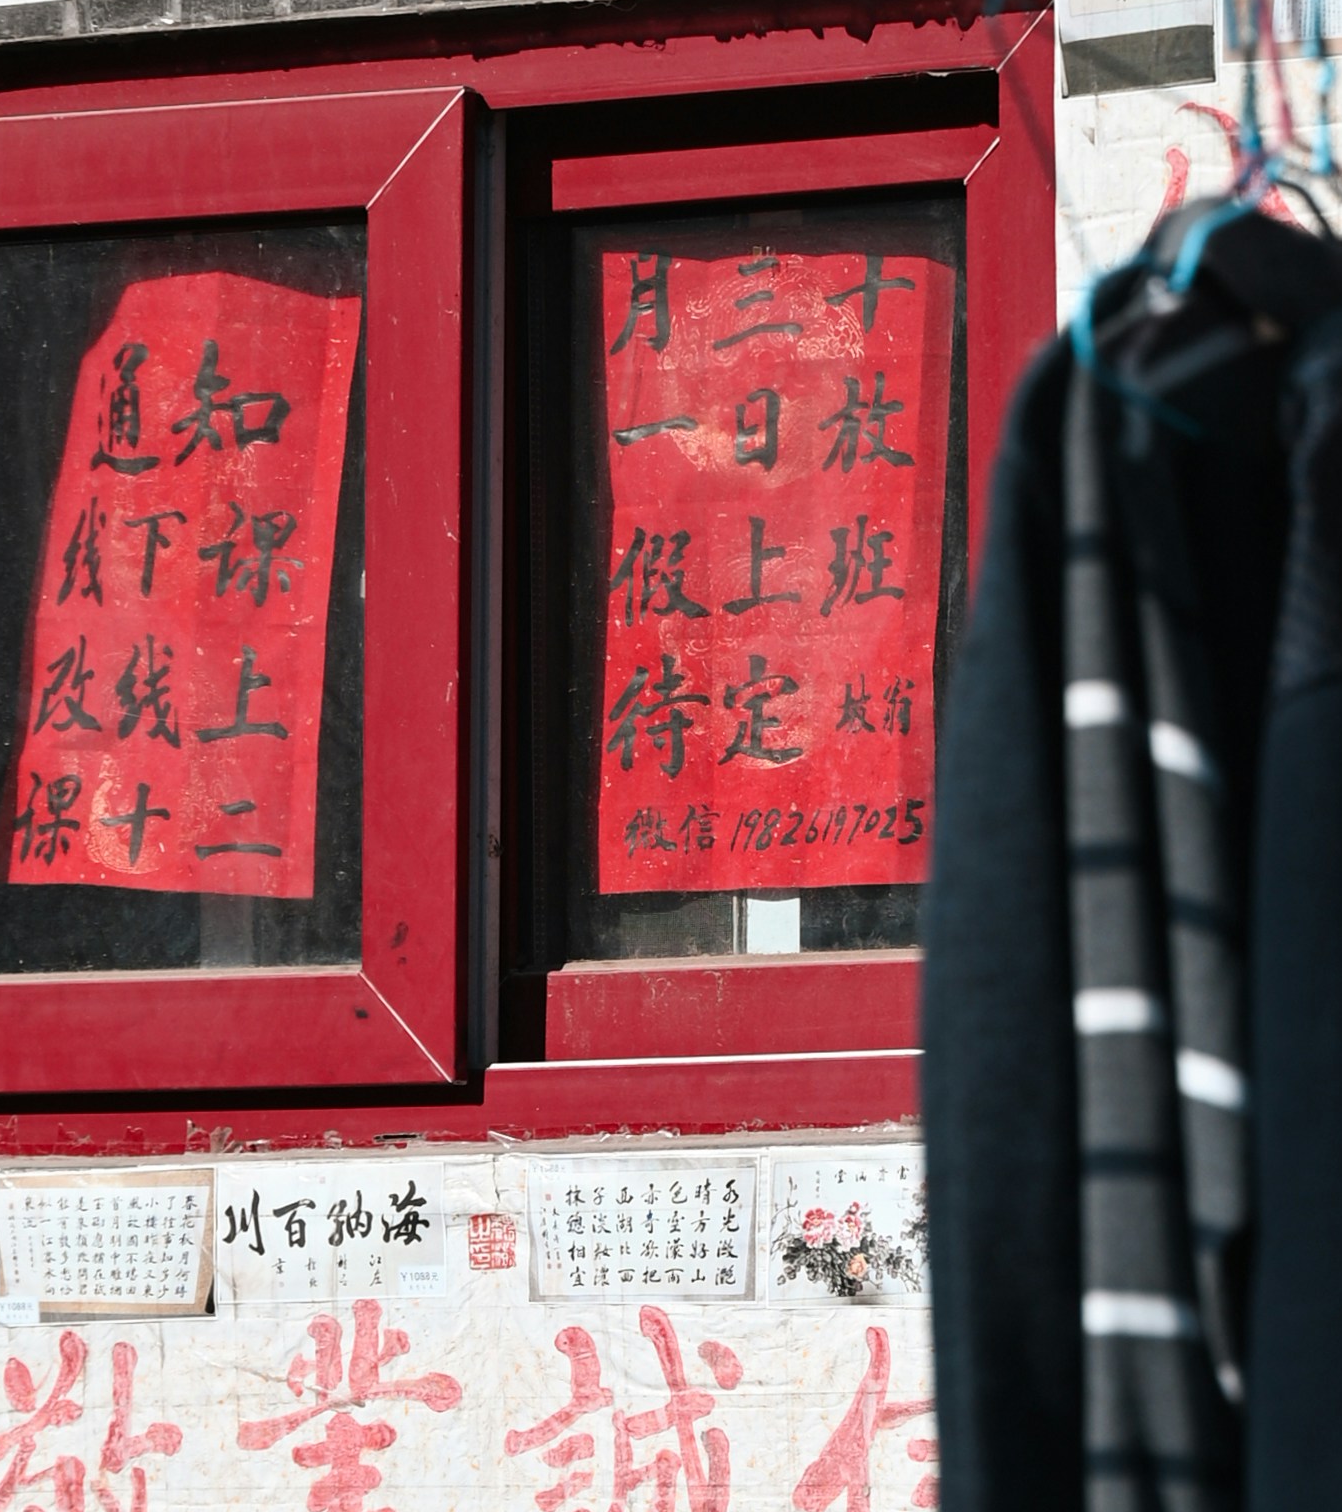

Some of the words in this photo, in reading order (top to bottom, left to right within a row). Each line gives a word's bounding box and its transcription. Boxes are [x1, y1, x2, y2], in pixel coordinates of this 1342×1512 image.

[610, 247, 917, 356] 月三十
[90, 339, 291, 471] 通知
[613, 371, 916, 472] 一日放
[56, 496, 305, 608] 线下课
[609, 515, 905, 628] 假上班
[33, 634, 288, 749] 改线上
[607, 654, 805, 779] 待定
[13, 772, 283, 868] 课十二
[624, 804, 720, 856] 微信
[730, 798, 925, 852] 19826197025
[616, 1186, 636, 1283] 西湖比西
[689, 1177, 717, 1284] 晴方好山
